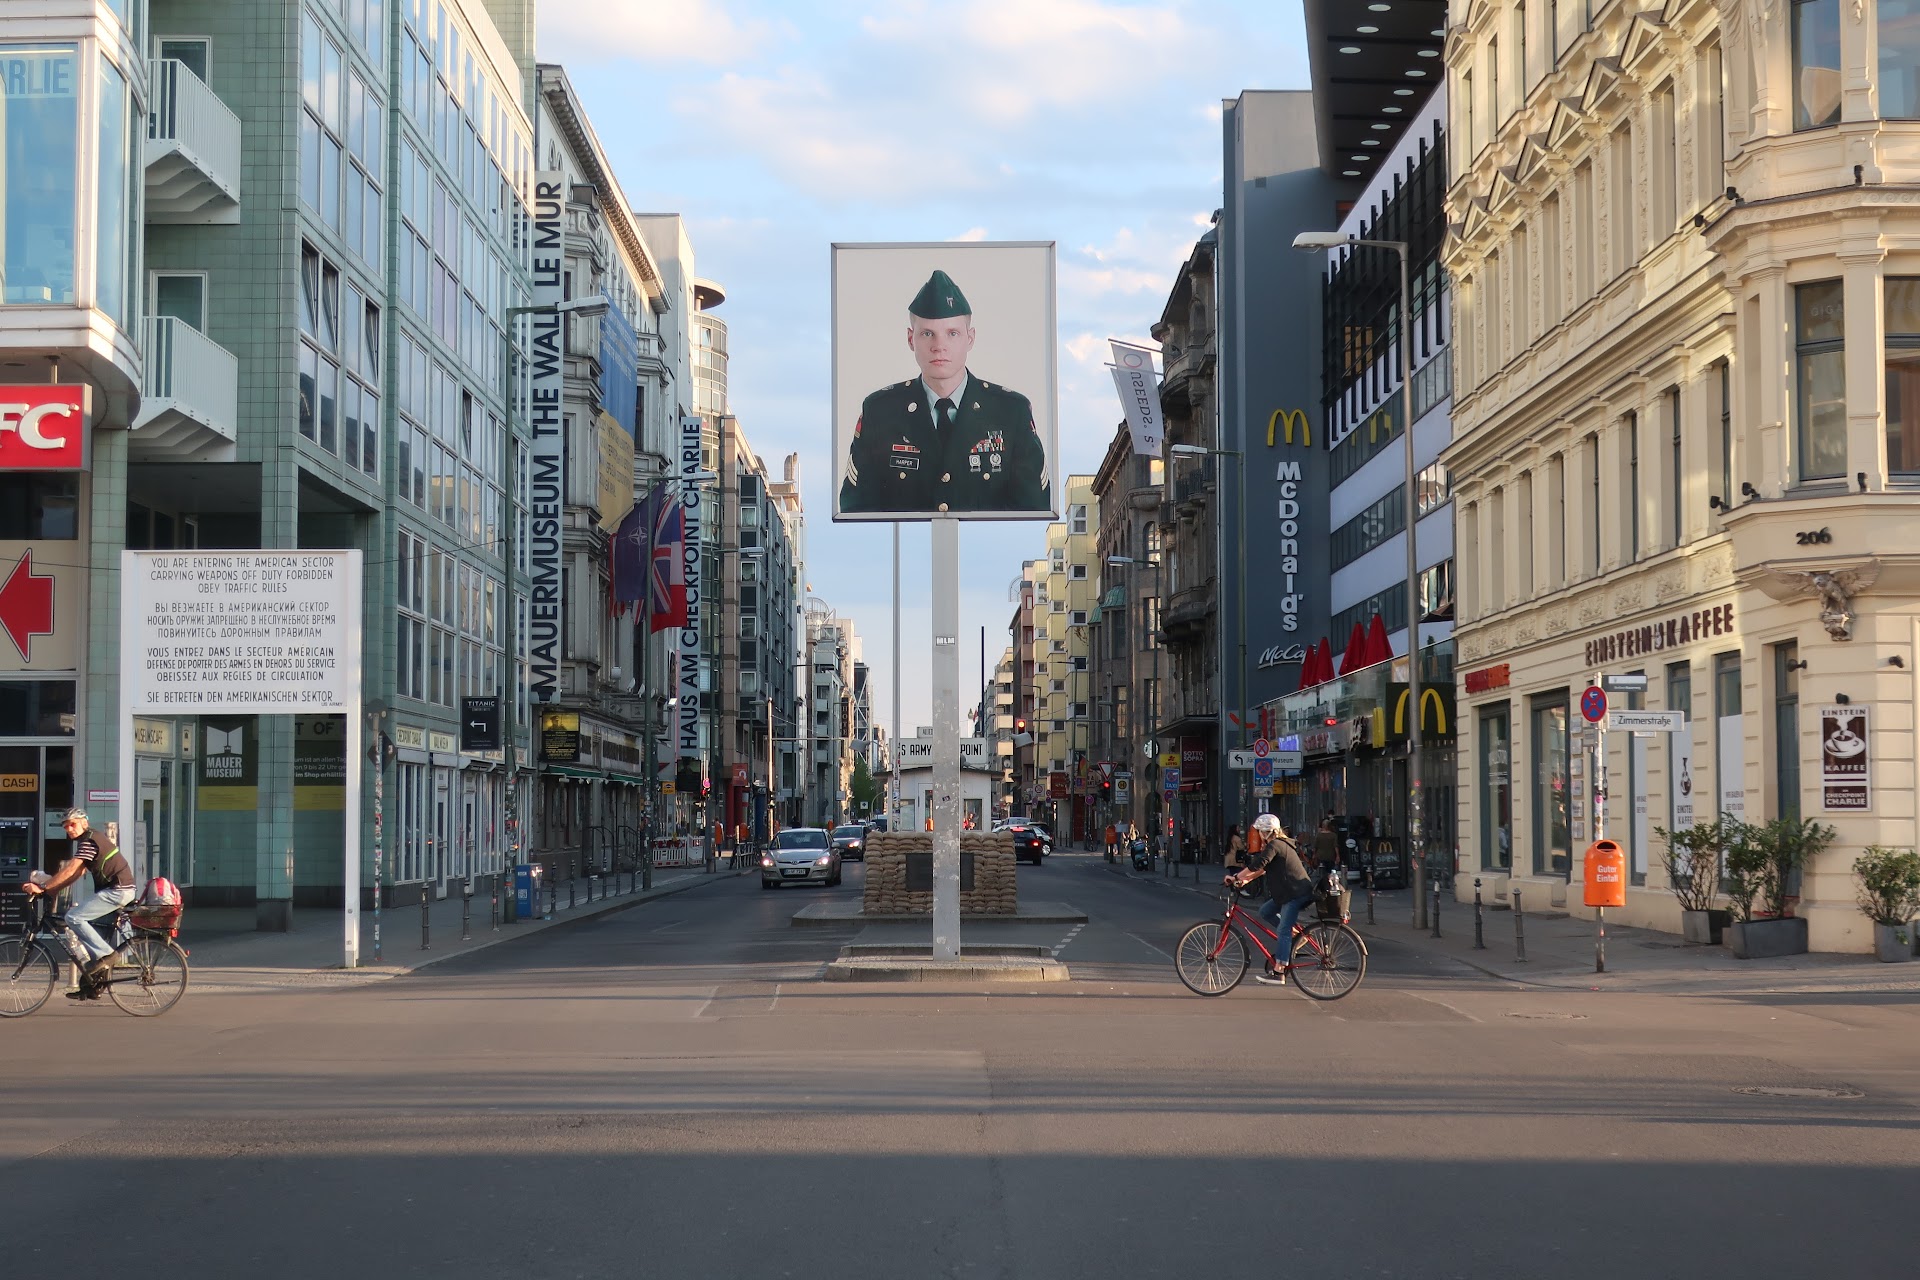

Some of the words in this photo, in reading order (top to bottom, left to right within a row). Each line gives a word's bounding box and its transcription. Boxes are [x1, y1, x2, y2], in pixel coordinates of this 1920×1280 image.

[535, 181, 562, 249] MUR
[534, 258, 560, 286] LE
[533, 388, 559, 439] THE
[0, 402, 71, 450] FC
[683, 424, 700, 509] CHARLIE
[1796, 527, 1832, 545] 206
[1276, 461, 1304, 632] McDonald's
[152, 558, 168, 568] YOU
[173, 557, 188, 568] ARE
[193, 556, 232, 568] ENTERING
[236, 556, 250, 568] THE
[254, 556, 297, 569] AMERICAN
[302, 556, 334, 567] SECTOR
[151, 570, 193, 580] CARRYING
[197, 570, 238, 580] WEAPONS
[242, 570, 257, 580] OFF
[262, 570, 282, 580] DUTY
[287, 570, 332, 580] FORBIDDEN
[531, 455, 559, 692] MAUERMUSEUM
[198, 583, 220, 593] OBEY
[224, 583, 257, 593] TRAFFIC
[262, 583, 287, 593] RULES
[682, 518, 699, 648] CHECKPOINT
[155, 603, 168, 613] ВЫ
[172, 601, 214, 614] ВЕЗЖАЕТЕ
[219, 603, 224, 612] В
[228, 601, 295, 612] АМЕРИКАНСКИЙ
[299, 602, 329, 612] СЕКТОР
[148, 614, 175, 626] НОСИТЬ
[175, 615, 204, 625] ОРУЖИЕ
[251, 615, 256, 625] В
[259, 615, 309, 625] НЕСЛУЖЕБНОЕ
[312, 615, 335, 625] ВРЕМЯ
[221, 628, 270, 637] ДОРОЖНЫМ
[276, 627, 321, 637] ПРАВИЛАМ
[1585, 625, 1652, 667] EINSTEIN
[1666, 603, 1734, 647] KAFFEE
[147, 647, 169, 657] VOUS
[175, 647, 203, 657] ENTREZ
[209, 647, 230, 657] DANS
[235, 647, 242, 656] LE
[247, 647, 282, 656] SECTEUR
[288, 644, 333, 657] AMÉRICAIN
[147, 659, 175, 669] DEFENSE
[178, 660, 186, 669] DE
[188, 659, 213, 669] PORTER
[214, 659, 227, 669] DES
[229, 659, 251, 668] ARMES
[254, 659, 262, 668] EN
[266, 658, 292, 670] DEHORS
[295, 659, 304, 668] DU
[307, 659, 335, 668] SERVICE
[157, 671, 197, 681] OBEISSEZ
[202, 671, 219, 681] AUX
[223, 671, 252, 681] REGLES
[257, 671, 266, 681] DE
[271, 671, 323, 680] CIRCULATION
[681, 654, 698, 689] AM
[147, 692, 159, 703] SIE
[164, 692, 203, 703] BETRETEN
[207, 691, 222, 702] DEN
[226, 691, 297, 702] AMERIKANISCHEN
[302, 691, 333, 703] SEKTOR
[681, 695, 698, 749] HAUS
[1618, 715, 1672, 727] Zimmerstraße
[314, 722, 335, 735] OF
[910, 744, 932, 756] ARMY
[960, 743, 983, 756] POINT
[206, 757, 242, 768] MAUER
[206, 769, 242, 778] MUSEUM
[2, 778, 35, 788] CASH
[1597, 865, 1617, 873] Guter
[1597, 874, 1619, 883] Einfall
